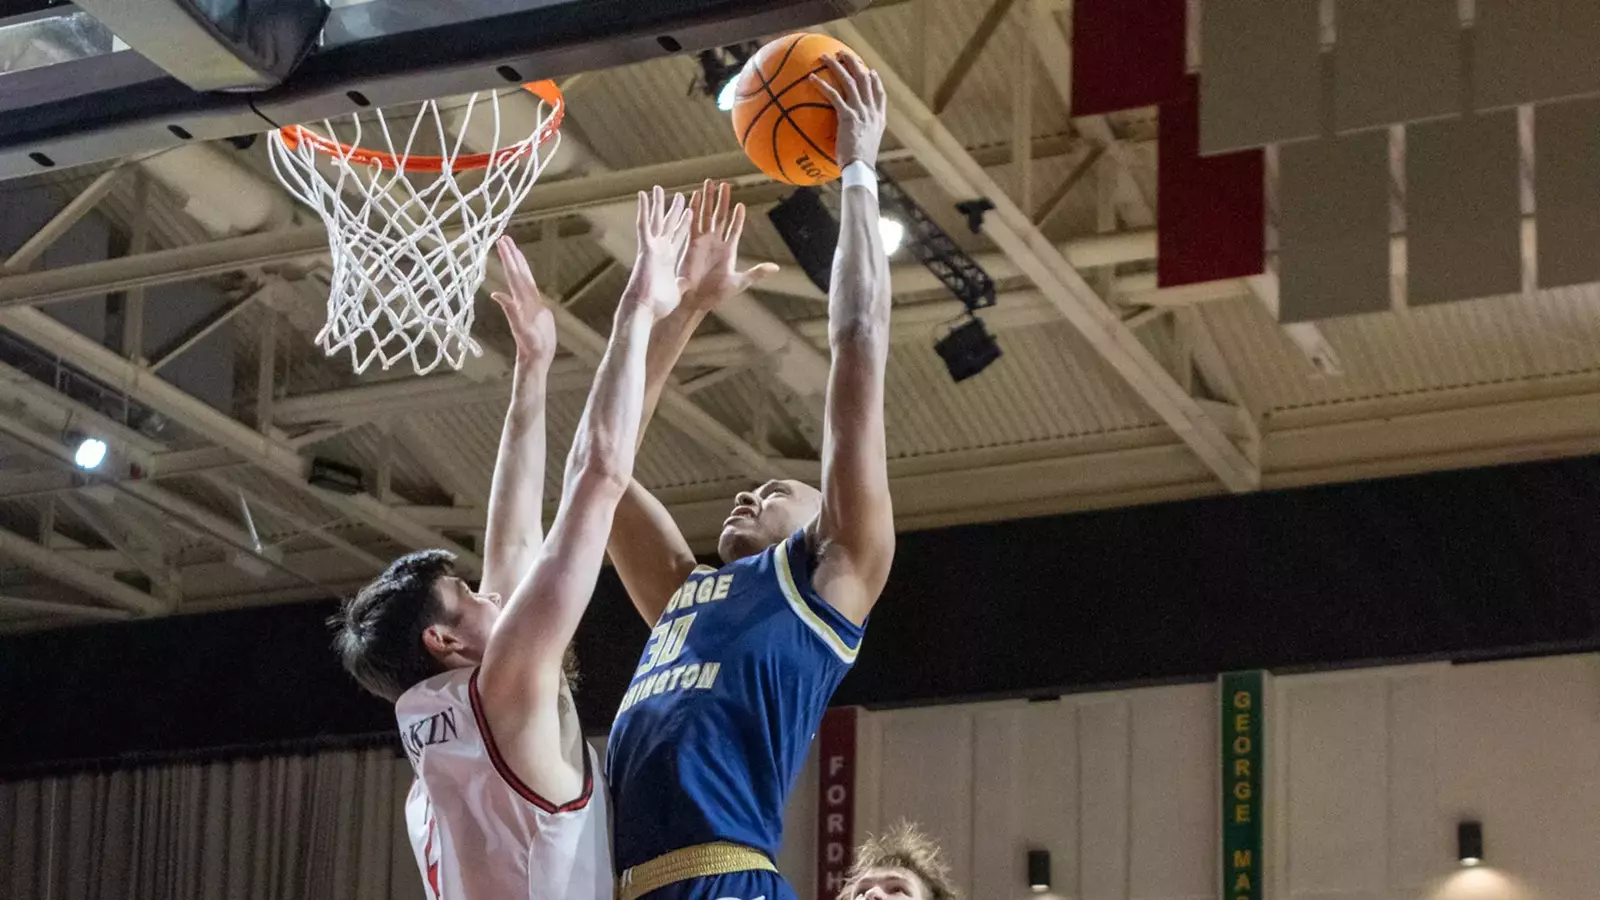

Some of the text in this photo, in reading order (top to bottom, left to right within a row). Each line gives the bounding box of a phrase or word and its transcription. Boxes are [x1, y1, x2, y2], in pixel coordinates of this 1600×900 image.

[634, 611, 698, 679] 30
[1233, 691, 1252, 900] GEORGE MA
